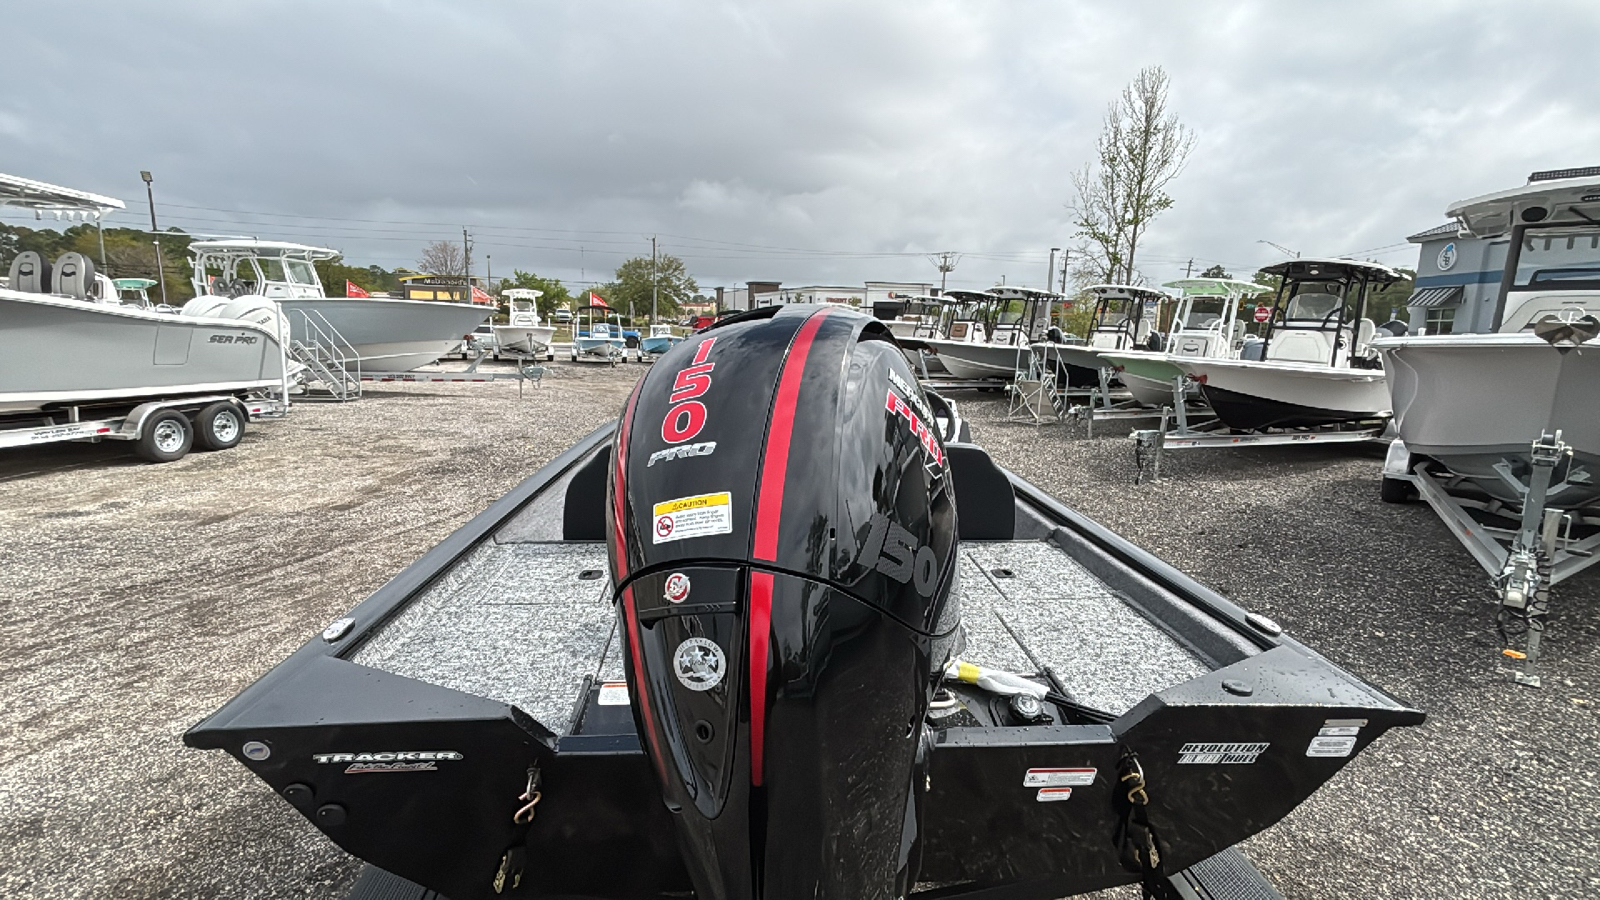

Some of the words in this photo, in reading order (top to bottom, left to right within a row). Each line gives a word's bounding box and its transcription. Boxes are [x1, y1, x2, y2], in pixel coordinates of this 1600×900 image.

[208, 334, 234, 344] SEA
[234, 336, 259, 345] PRO
[661, 336, 718, 444] 150
[646, 441, 718, 468] PRO
[678, 499, 708, 510] CAUTION
[856, 511, 938, 598] 150
[1180, 744, 1269, 753] REVOLUTION
[313, 751, 457, 763] TRACKER
